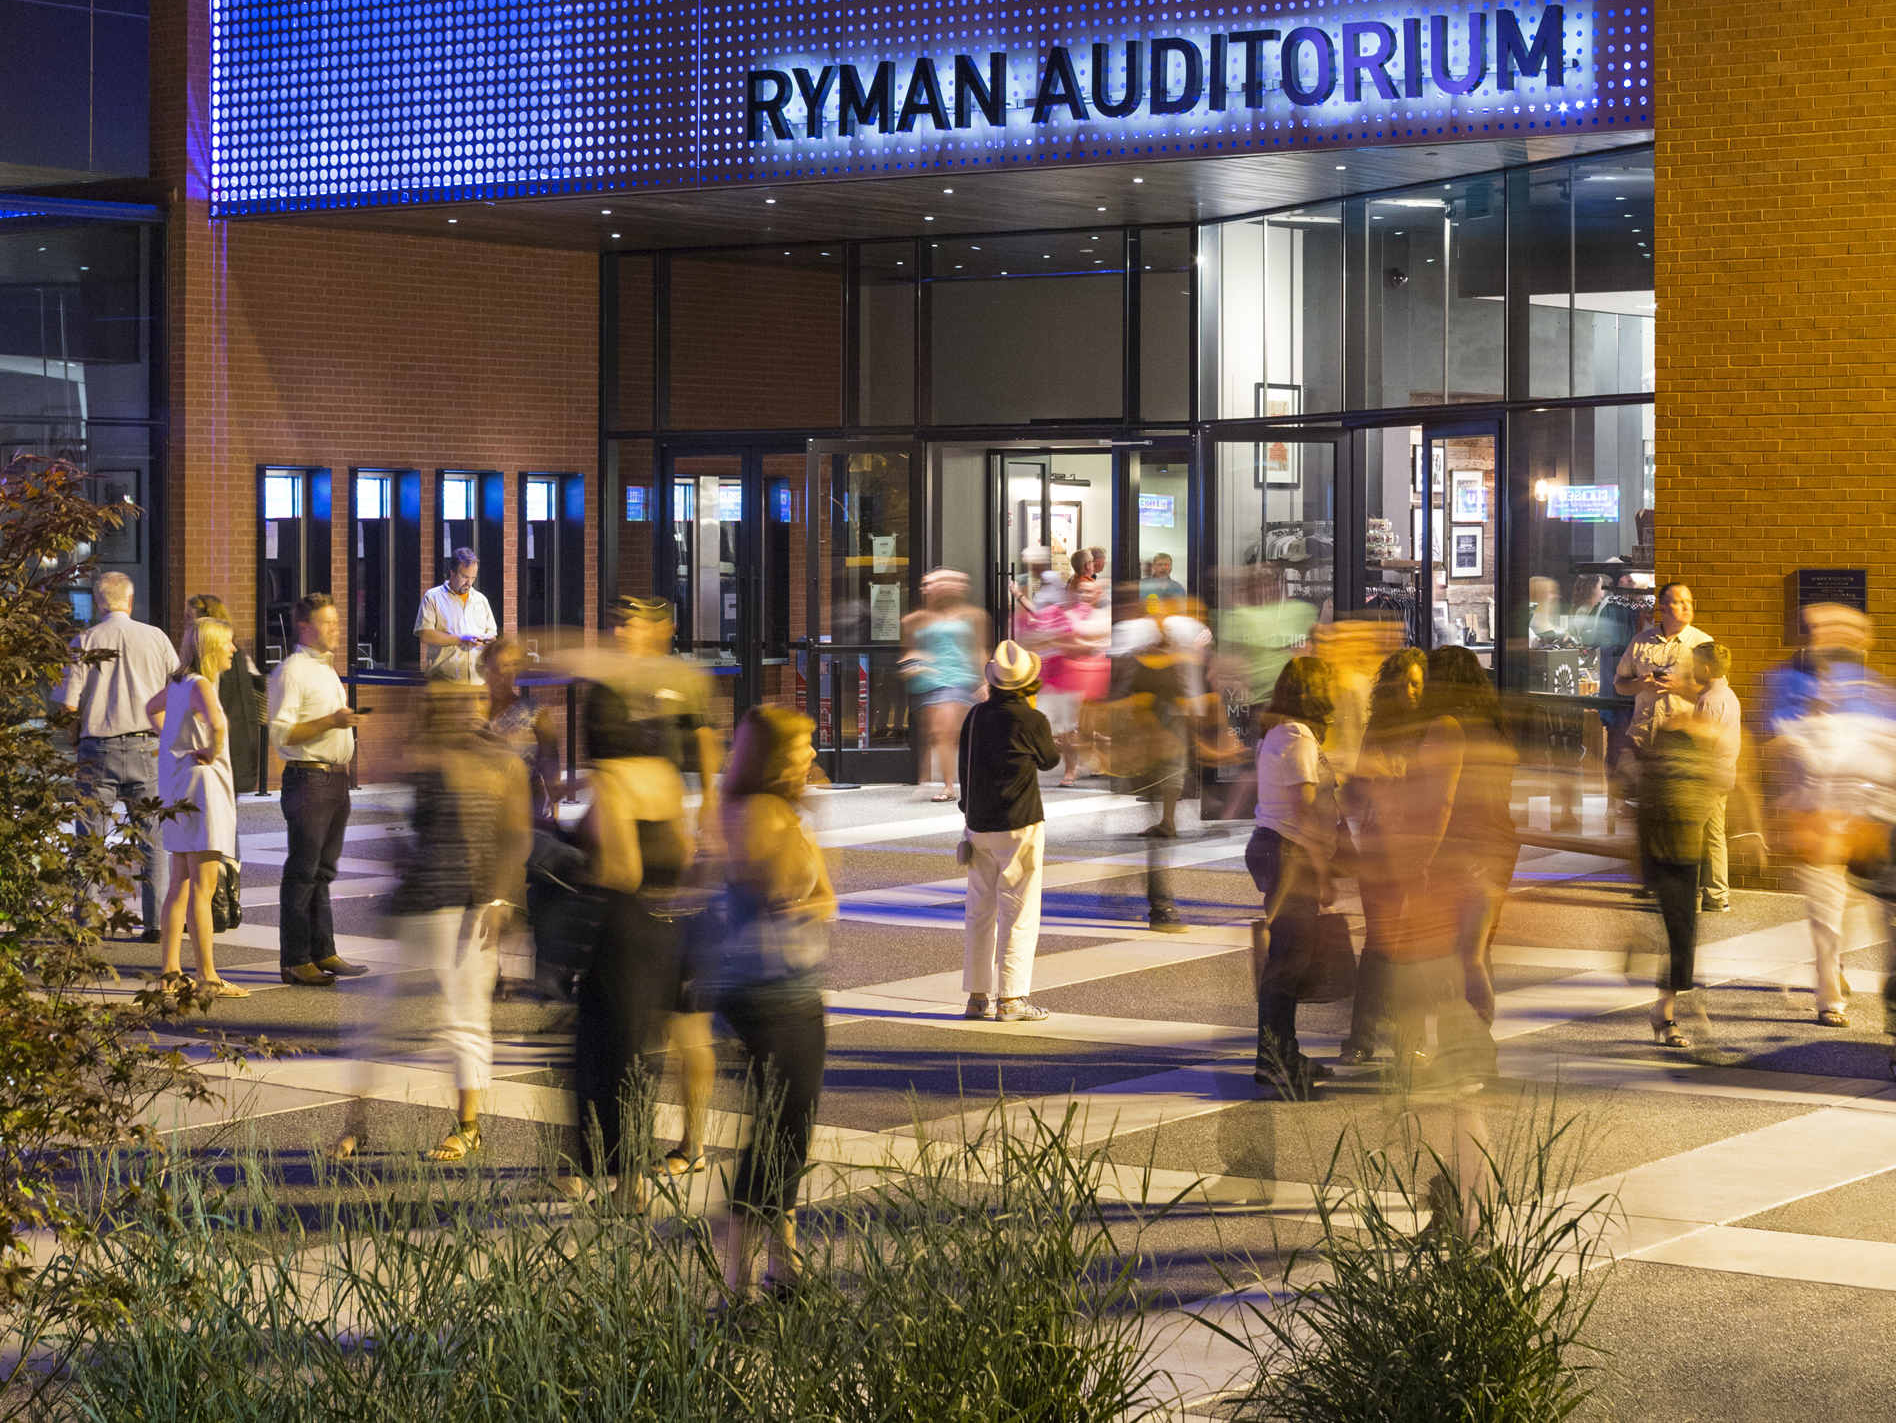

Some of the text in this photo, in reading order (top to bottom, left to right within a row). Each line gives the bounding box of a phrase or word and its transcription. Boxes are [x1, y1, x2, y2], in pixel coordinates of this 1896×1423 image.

[747, 5, 1564, 142] RYMAN AUDITORIUM
[719, 491, 741, 503] CLOSE
